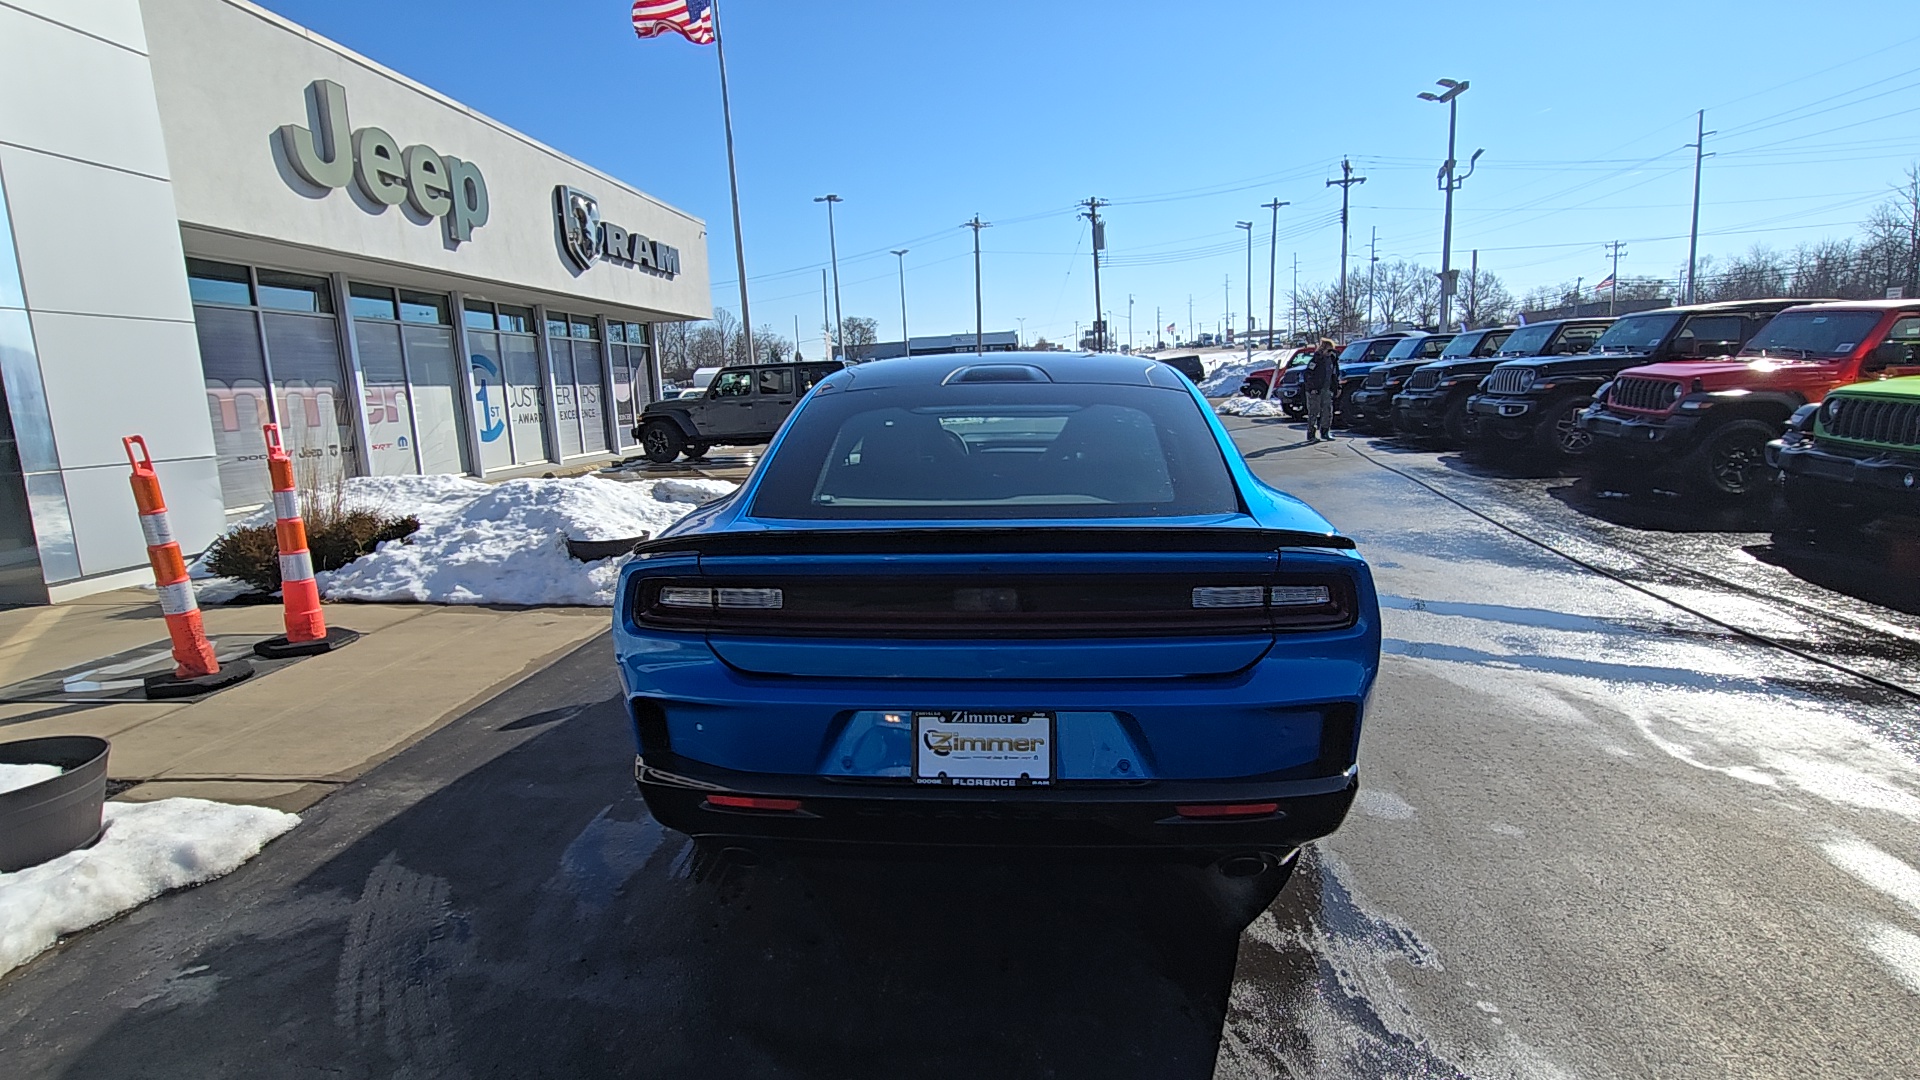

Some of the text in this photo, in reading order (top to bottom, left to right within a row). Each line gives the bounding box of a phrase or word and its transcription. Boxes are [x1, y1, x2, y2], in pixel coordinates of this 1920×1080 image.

[270, 79, 490, 245] Jeep
[602, 222, 681, 276] RAM
[518, 408, 596, 425] AWARD EXCEENCE
[237, 453, 268, 462] DOD
[299, 446, 323, 460] Jeep
[951, 711, 1015, 723] Zimmer
[930, 731, 1045, 752] Zimmer
[952, 779, 1017, 787] FLORENCE
